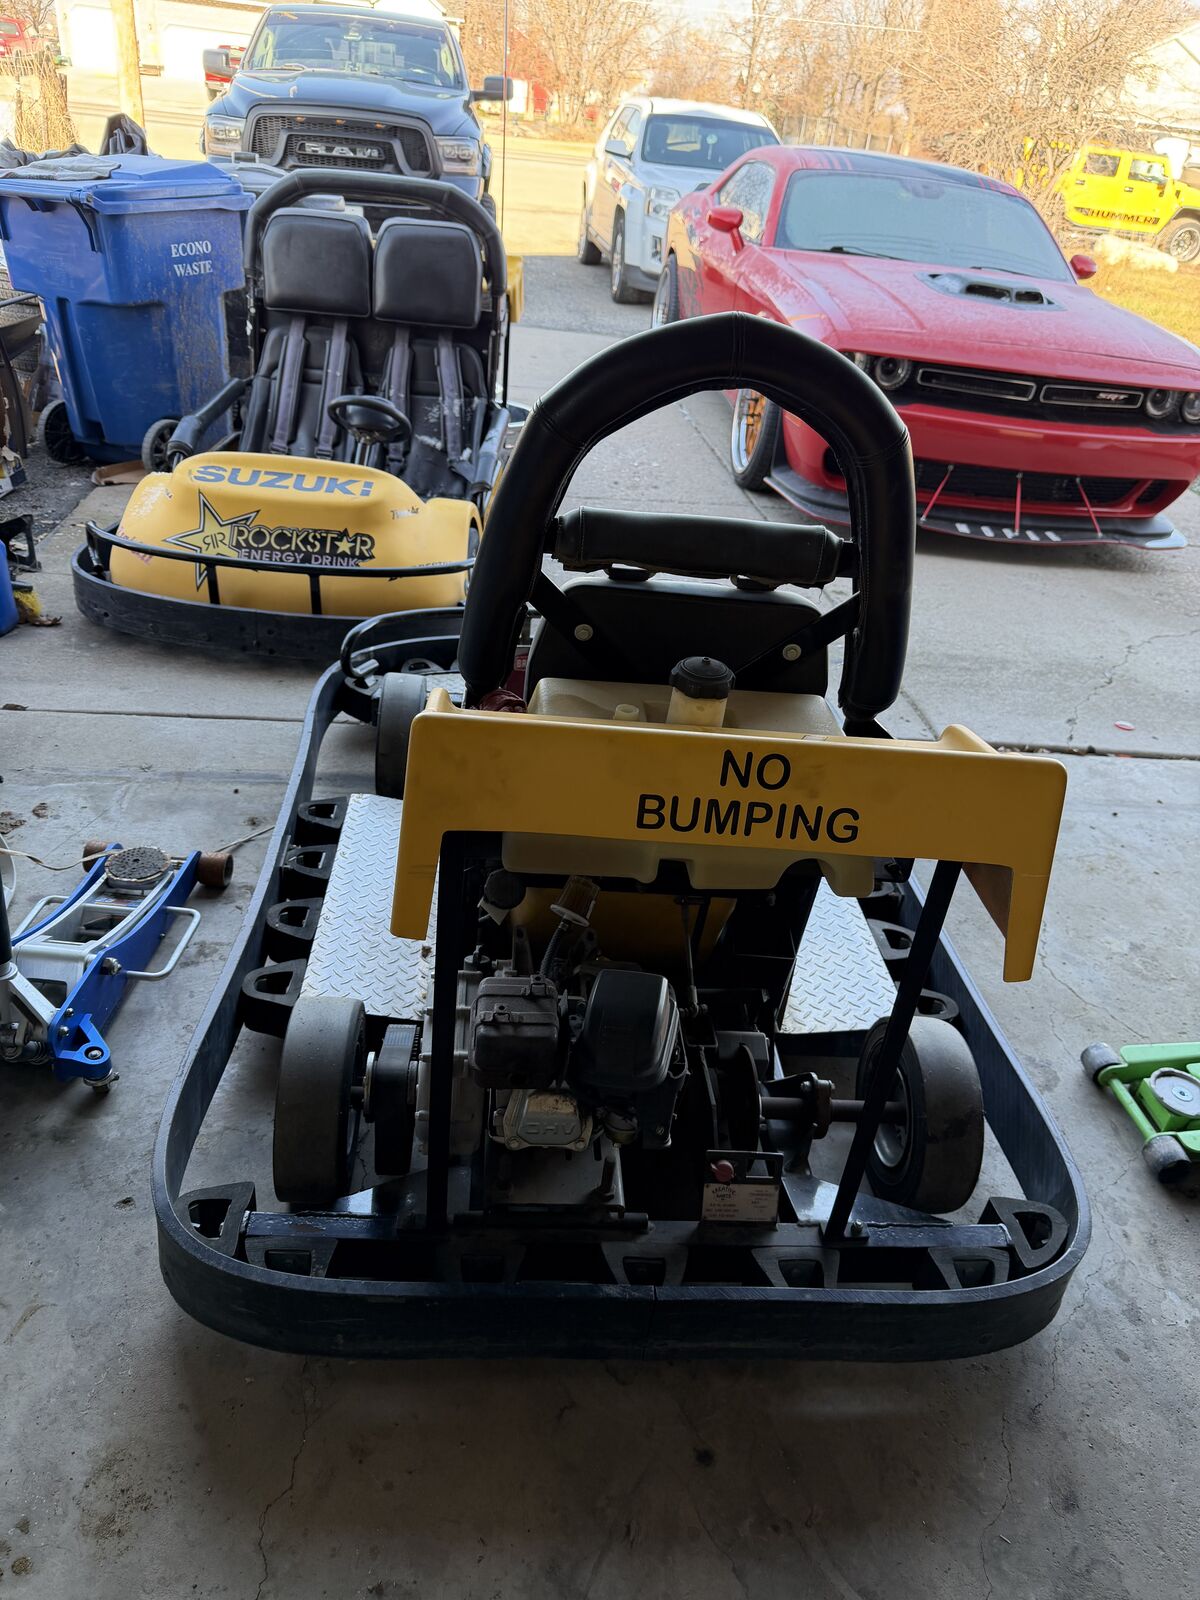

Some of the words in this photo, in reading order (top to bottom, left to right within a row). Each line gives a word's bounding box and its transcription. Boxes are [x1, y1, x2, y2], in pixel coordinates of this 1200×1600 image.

[1091, 207, 1154, 225] HUMMER
[170, 240, 212, 258] ECONO
[173, 259, 213, 278] WASTE
[193, 465, 374, 497] SUZUKI
[240, 548, 304, 564] ENERGY
[310, 553, 360, 568] DRINK
[720, 749, 791, 790] NO
[636, 793, 860, 843] BUMPING
